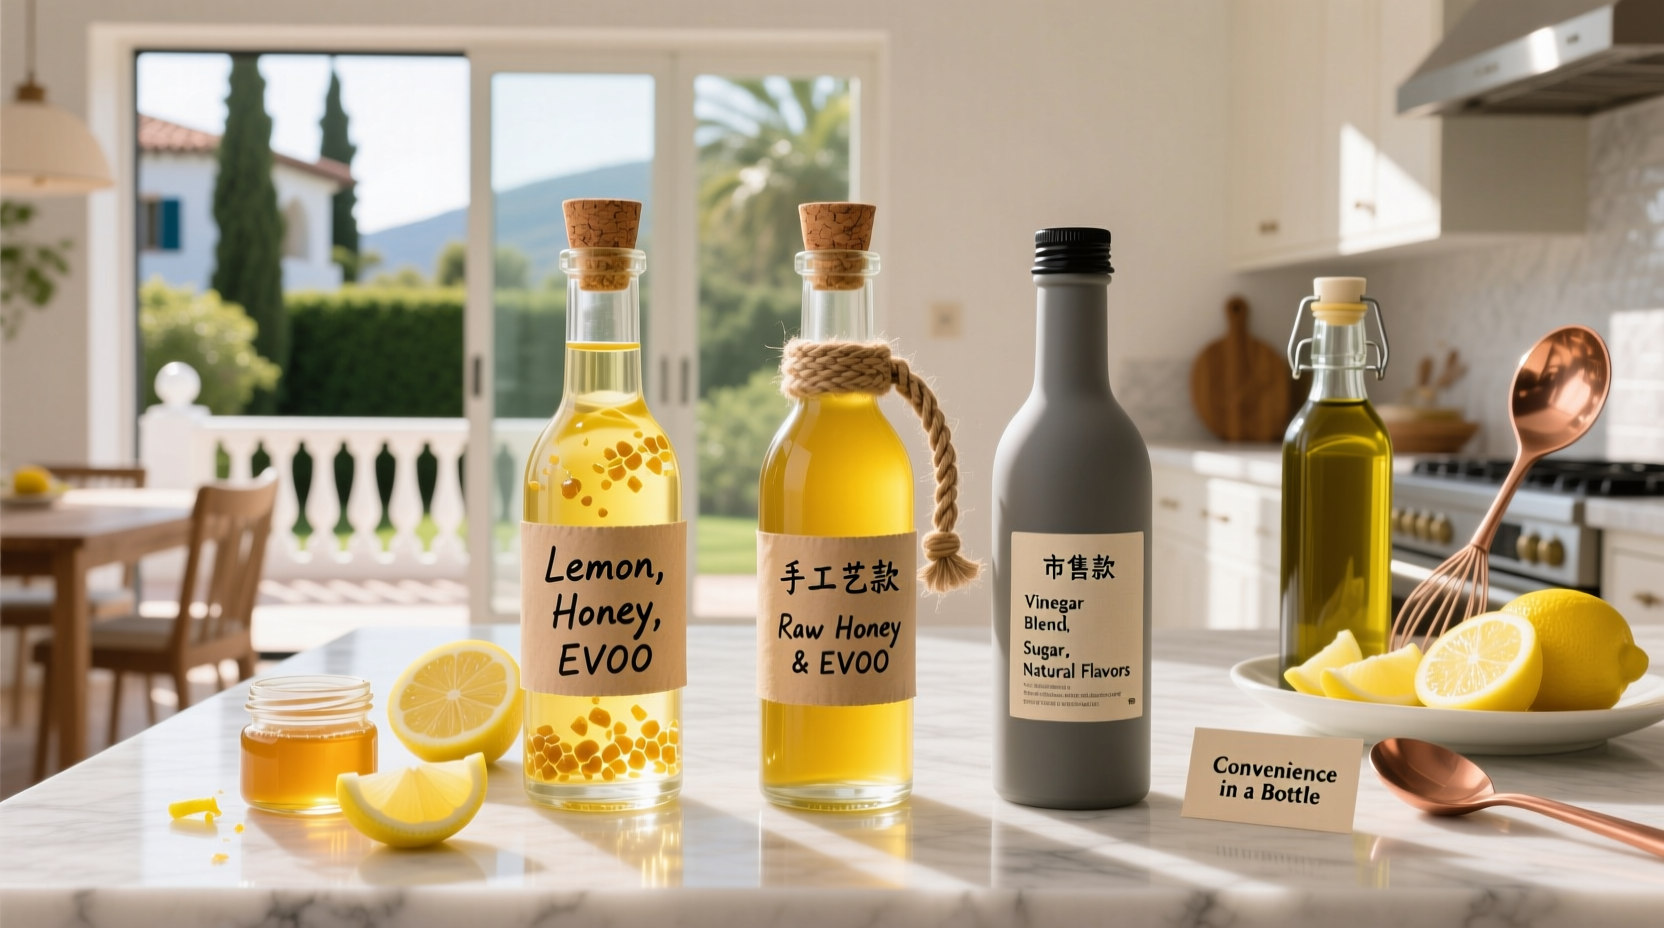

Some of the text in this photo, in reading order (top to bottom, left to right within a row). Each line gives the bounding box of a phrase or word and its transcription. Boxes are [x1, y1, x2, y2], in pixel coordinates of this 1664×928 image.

[544, 545, 664, 586] Lemon,
[780, 558, 900, 595] 手工艺款
[1043, 553, 1116, 581] 市售款
[552, 592, 661, 640] Honey,
[1024, 594, 1085, 613] Vinegar
[778, 612, 902, 649] Raw Honey
[1024, 614, 1070, 633] Blend,
[558, 643, 653, 677] EVOO
[791, 649, 890, 675] & EVOO
[1023, 640, 1070, 661] Sugar,
[1023, 662, 1131, 679] Natural Flavors
[1213, 755, 1338, 783] Convenience
[1219, 779, 1321, 805] in a Bottle
